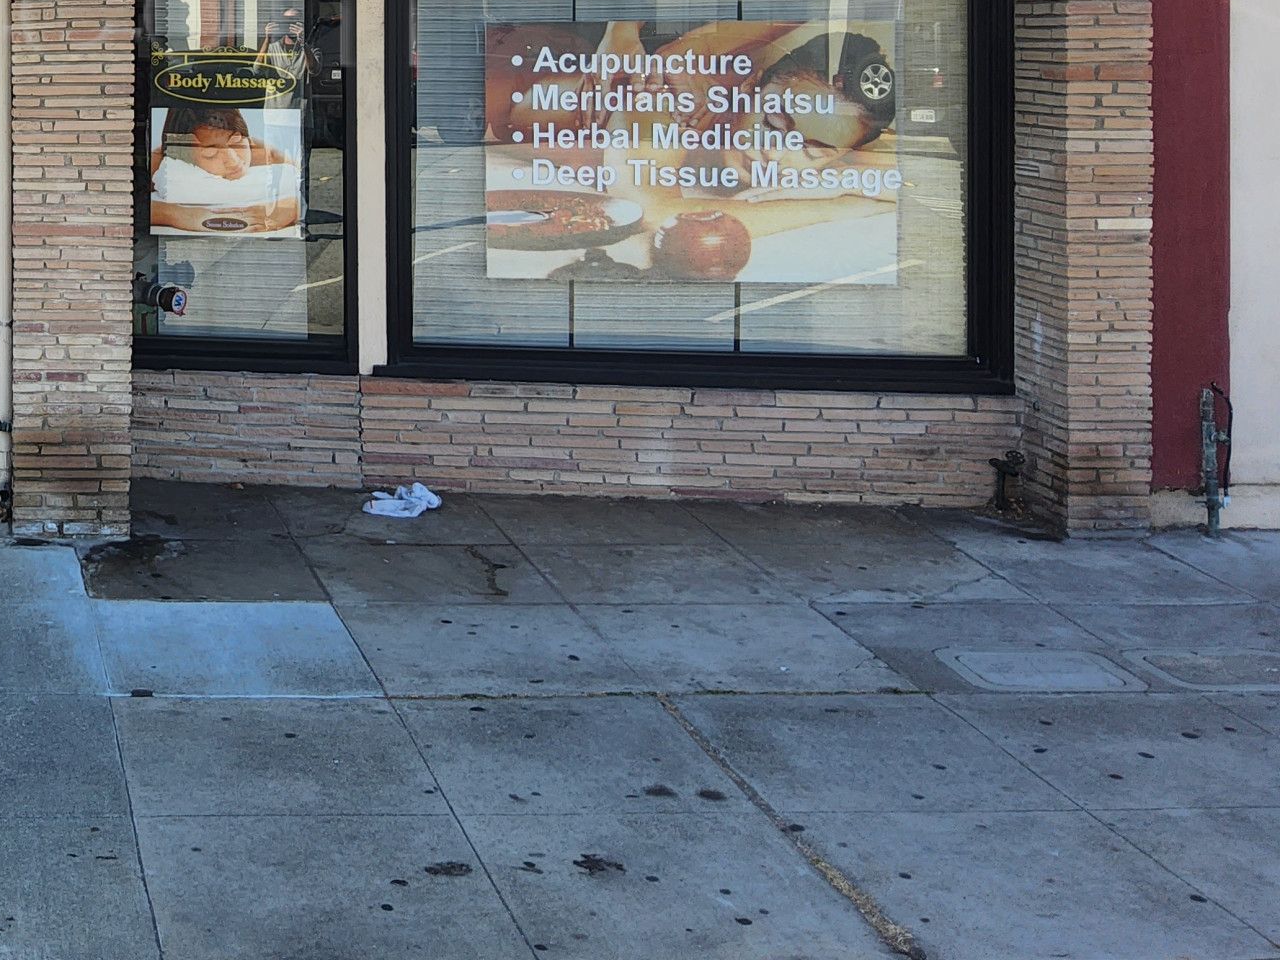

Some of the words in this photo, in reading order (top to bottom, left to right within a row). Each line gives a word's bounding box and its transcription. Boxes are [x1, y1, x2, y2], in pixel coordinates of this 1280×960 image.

[532, 46, 752, 78] Acupuncture
[168, 73, 213, 92] Body
[215, 73, 286, 92] Massage
[532, 83, 694, 113] Meridians
[708, 86, 834, 115] Shiatsu
[532, 122, 639, 150] Herbal
[652, 124, 804, 151] Medicine
[531, 159, 616, 192] Deep
[627, 159, 739, 188] Tissue
[751, 161, 902, 197] Massage
